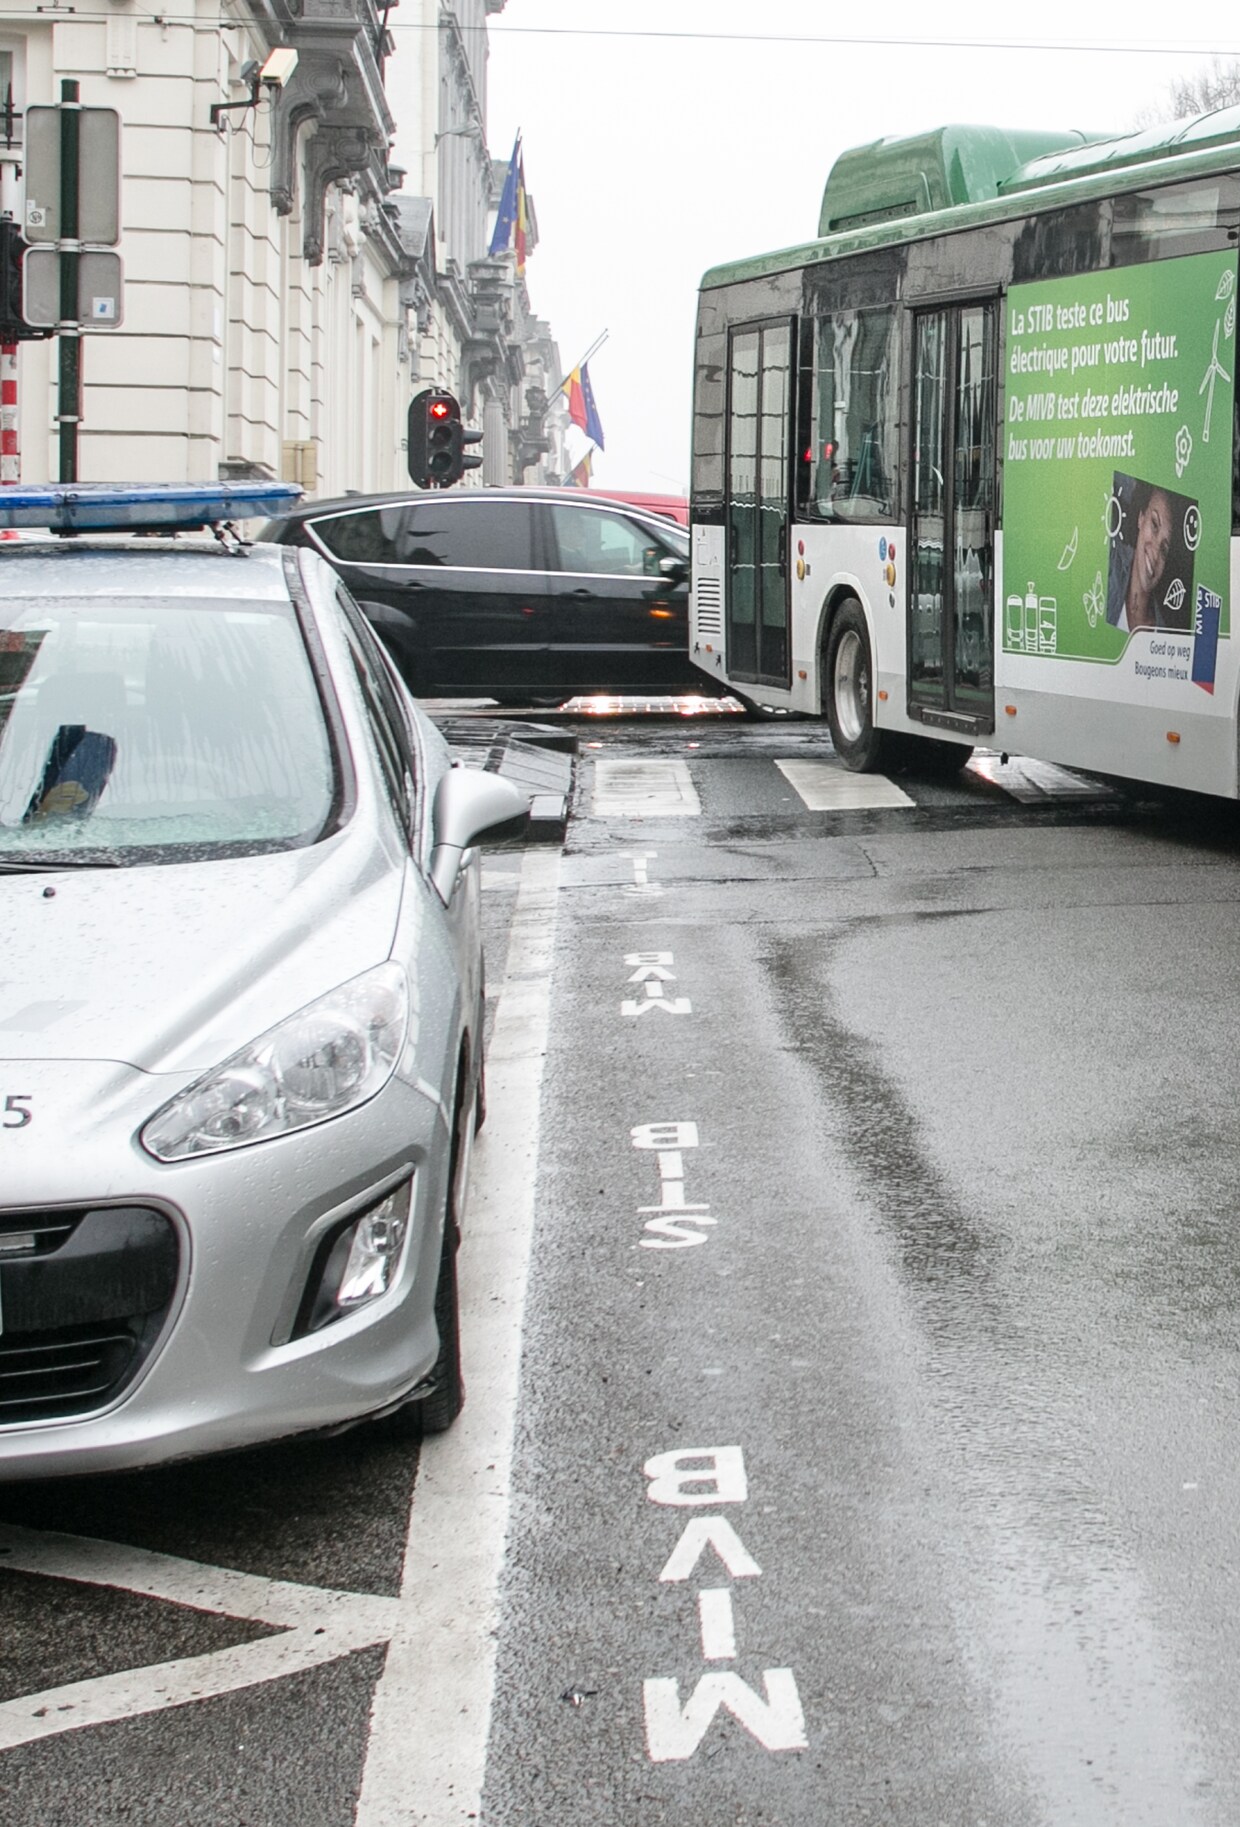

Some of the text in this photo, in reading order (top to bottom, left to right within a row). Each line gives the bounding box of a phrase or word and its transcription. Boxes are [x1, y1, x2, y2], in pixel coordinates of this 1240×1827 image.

[1011, 293, 1130, 336] La STIB teste ce bus
[1010, 328, 1179, 378] électrique pour votre futur.
[1008, 381, 1179, 423] De MIVB test deze elektrische
[1007, 427, 1136, 461] bus voor uw toekomst.
[1135, 660, 1188, 680] Bougeons mieux
[1150, 640, 1191, 662] Goed op weg
[620, 951, 693, 1017] MIVB
[3, 1095, 32, 1129] 5
[630, 1121, 719, 1250] STIB
[643, 1445, 809, 1763] MIVB
